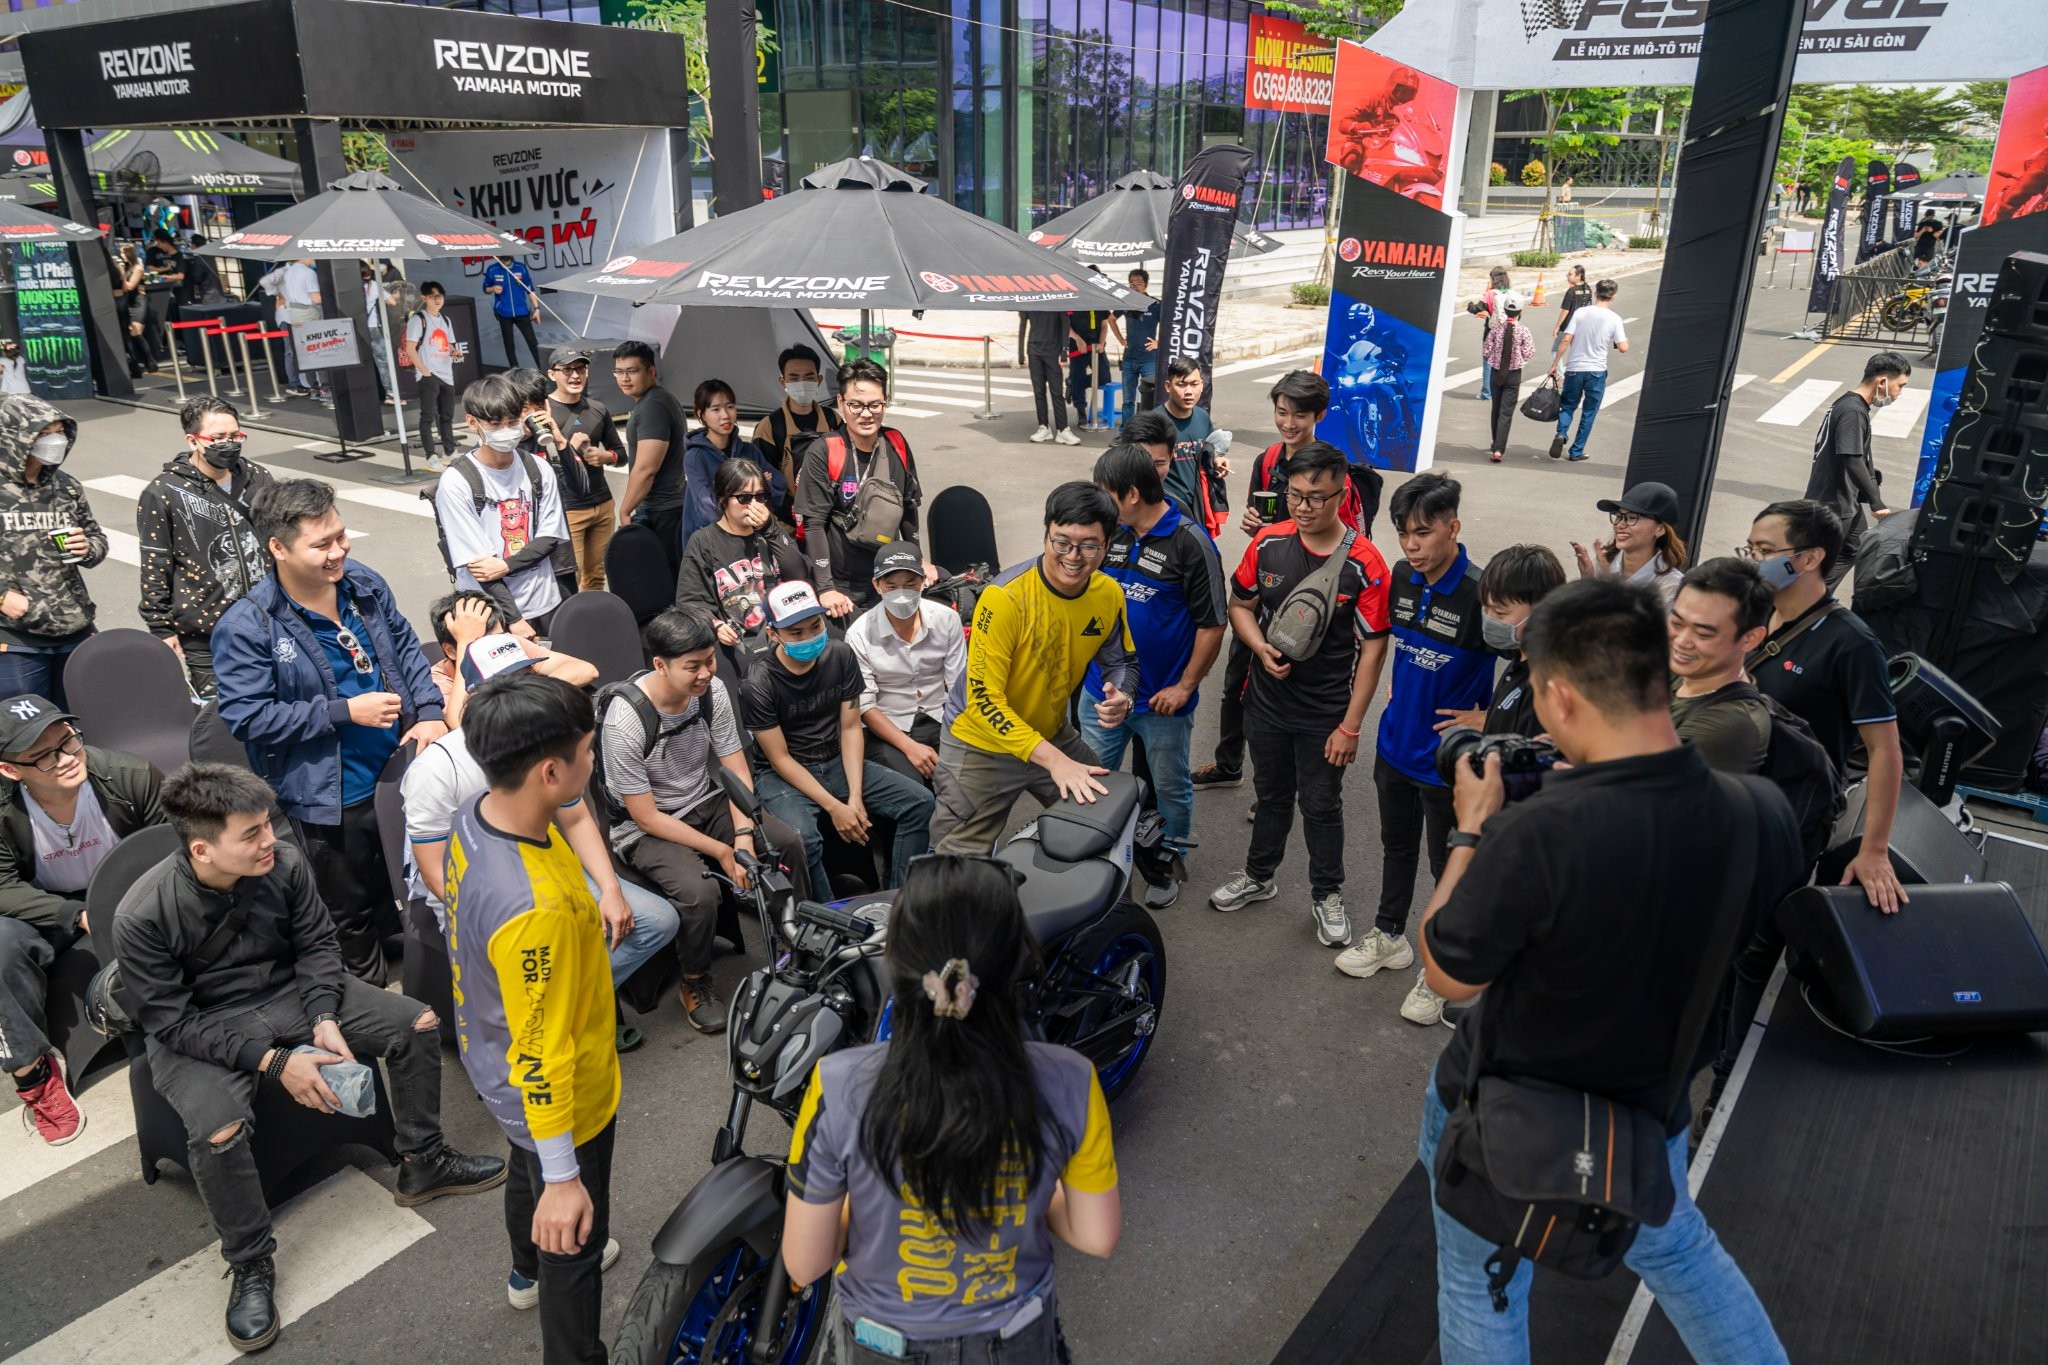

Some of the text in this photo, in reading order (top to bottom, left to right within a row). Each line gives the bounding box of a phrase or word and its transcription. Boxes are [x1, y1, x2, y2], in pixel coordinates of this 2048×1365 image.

[1570, 41, 1586, 57] LỄ
[1587, 42, 1610, 59] HỘI
[1612, 44, 1631, 56] XE
[1633, 40, 1676, 56] MÔ-TÔ
[1818, 36, 1842, 52] TẠI
[1844, 33, 1870, 48] SÀI
[1873, 32, 1905, 48] GÒN
[99, 41, 195, 80] REVZONE
[433, 38, 592, 78] REVZONE
[1255, 36, 1334, 75] NOW LEASING
[113, 79, 191, 99] YAMAHA MOTOR
[453, 76, 582, 98] YAMAHA MOTOR
[1253, 71, 1332, 106] 0369.88.8282
[493, 148, 542, 167] REVZONE
[191, 172, 264, 187] MONSTER
[499, 163, 540, 176] YAMAHA MOTOR
[469, 167, 580, 219] KHU VỰC
[1195, 185, 1237, 208] YAMAHA
[1868, 194, 1882, 246] REVZONE
[297, 239, 405, 248] REVZONE
[551, 206, 598, 269] KÝ
[1071, 237, 1155, 252] REVZONE
[1827, 208, 1840, 282] REVZONE
[1078, 248, 1145, 258] YAMAHA MOTOR
[1363, 239, 1445, 269] YAMAHA
[697, 270, 891, 291] REVZONE
[1351, 266, 1436, 279] Revs Your Heart
[949, 273, 1080, 293] YAMAHA
[17, 289, 80, 305] MONSTER
[711, 288, 868, 300] YAMAHA MOTOR
[20, 303, 80, 311] ENERGY
[1168, 258, 1192, 366] YAMAHA MOTO
[306, 328, 339, 342] KHU VỰC
[1148, 547, 1167, 562] YAMAHA
[976, 605, 989, 631] FOR
[983, 610, 994, 635] MADE
[1437, 608, 1461, 623] YAMAHA
[1419, 647, 1455, 663] 155
[1792, 664, 1803, 675] LG
[10, 699, 41, 721] NY
[42, 848, 65, 864] STAY
[520, 948, 538, 985] FOR
[539, 945, 552, 984] MADE
